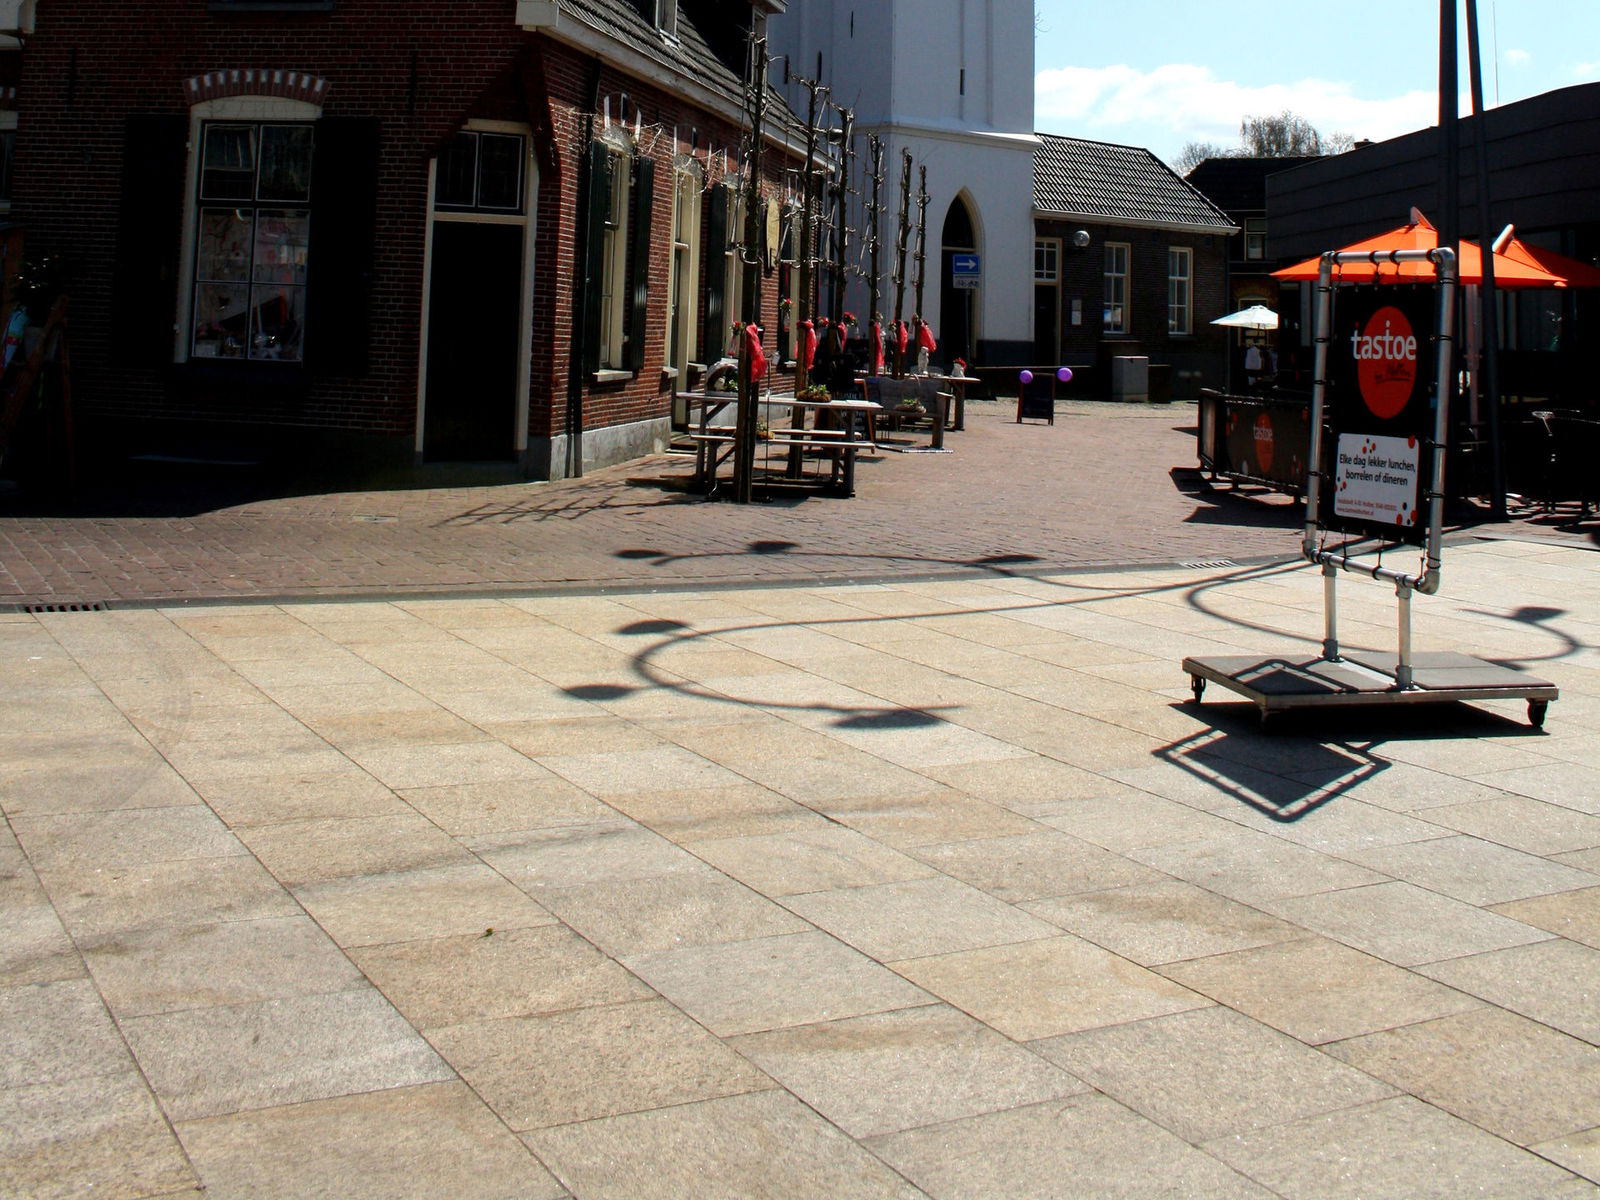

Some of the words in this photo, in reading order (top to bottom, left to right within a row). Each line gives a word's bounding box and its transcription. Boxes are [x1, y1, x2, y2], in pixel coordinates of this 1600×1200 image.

[1350, 321, 1417, 360] tastoe
[1340, 453, 1352, 465] Elke
[1353, 454, 1366, 468] dag
[1367, 455, 1387, 468] lekker
[1388, 457, 1416, 473] lunchen,
[1345, 469, 1373, 481] borrelen
[1374, 472, 1382, 482] of
[1382, 473, 1408, 486] dineren
